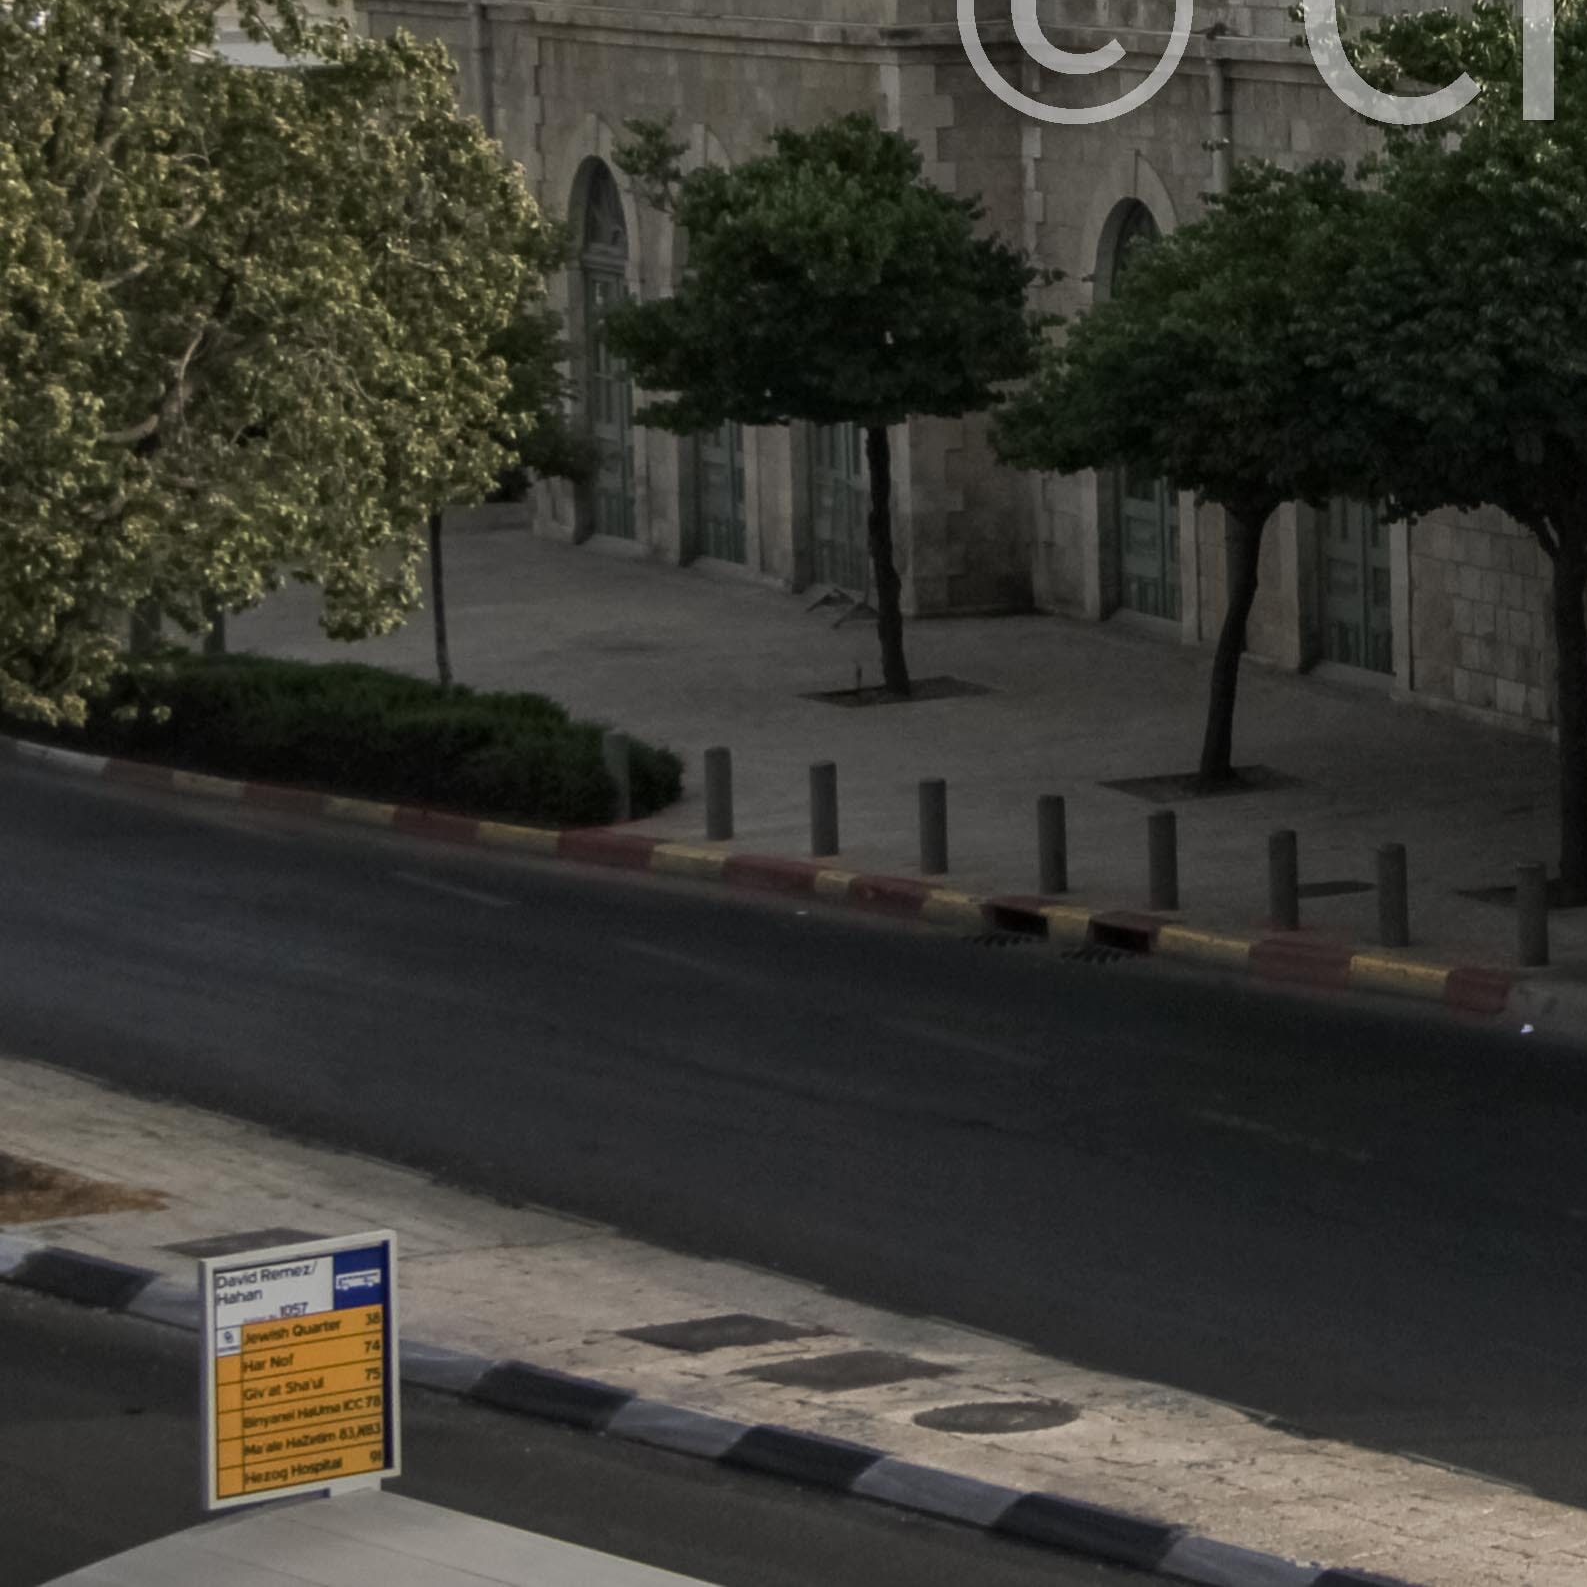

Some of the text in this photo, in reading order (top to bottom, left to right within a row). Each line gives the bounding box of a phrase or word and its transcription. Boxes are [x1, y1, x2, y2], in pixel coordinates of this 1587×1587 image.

[216, 1273, 257, 1288] David
[216, 1289, 263, 1305] Hahan
[244, 1327, 289, 1345] Jewish
[292, 1319, 341, 1337] Quarter
[243, 1340, 380, 1373] Har Nof 74
[365, 1367, 381, 1381] 75
[343, 1400, 363, 1411] ICC
[365, 1396, 381, 1408] 78
[291, 1457, 342, 1477] Hospital
